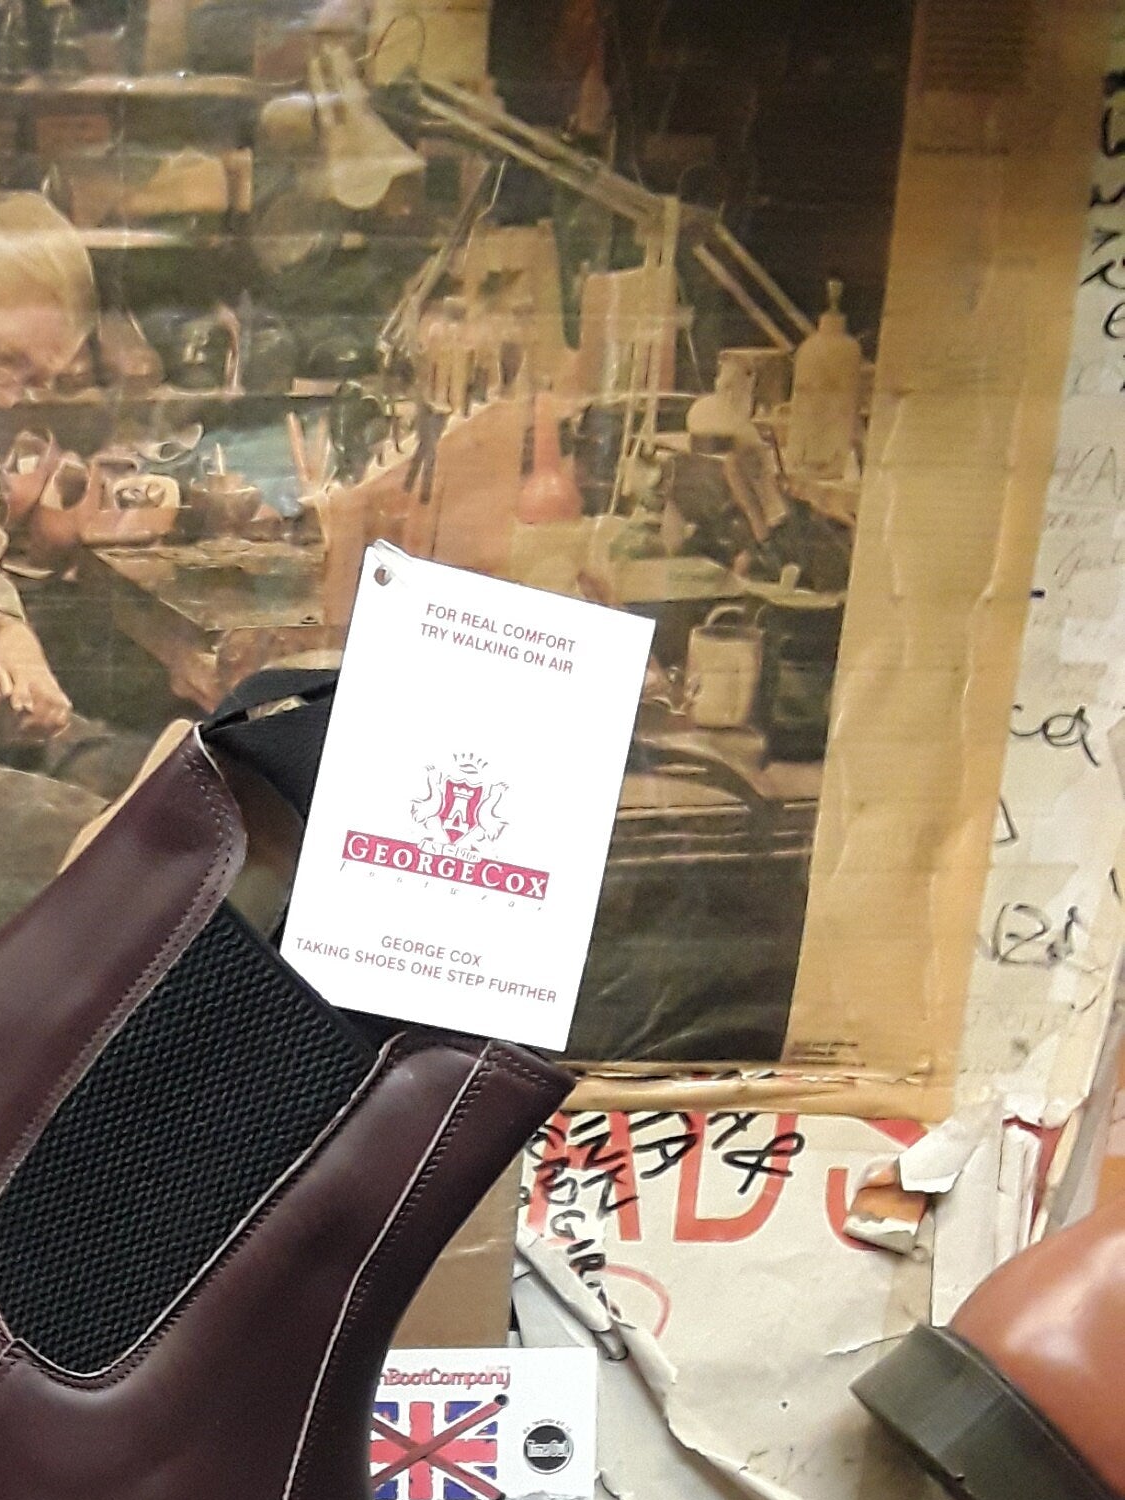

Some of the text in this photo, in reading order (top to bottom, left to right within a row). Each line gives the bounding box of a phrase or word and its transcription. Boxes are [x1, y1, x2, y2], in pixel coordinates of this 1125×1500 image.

[420, 622, 574, 675] TRY WALKING ON AIR
[426, 603, 576, 653] FOR REAL COMFORT
[296, 937, 557, 1003] TAKING SHOES ONE STEP FURTHER
[381, 935, 483, 968] GEORGE COX
